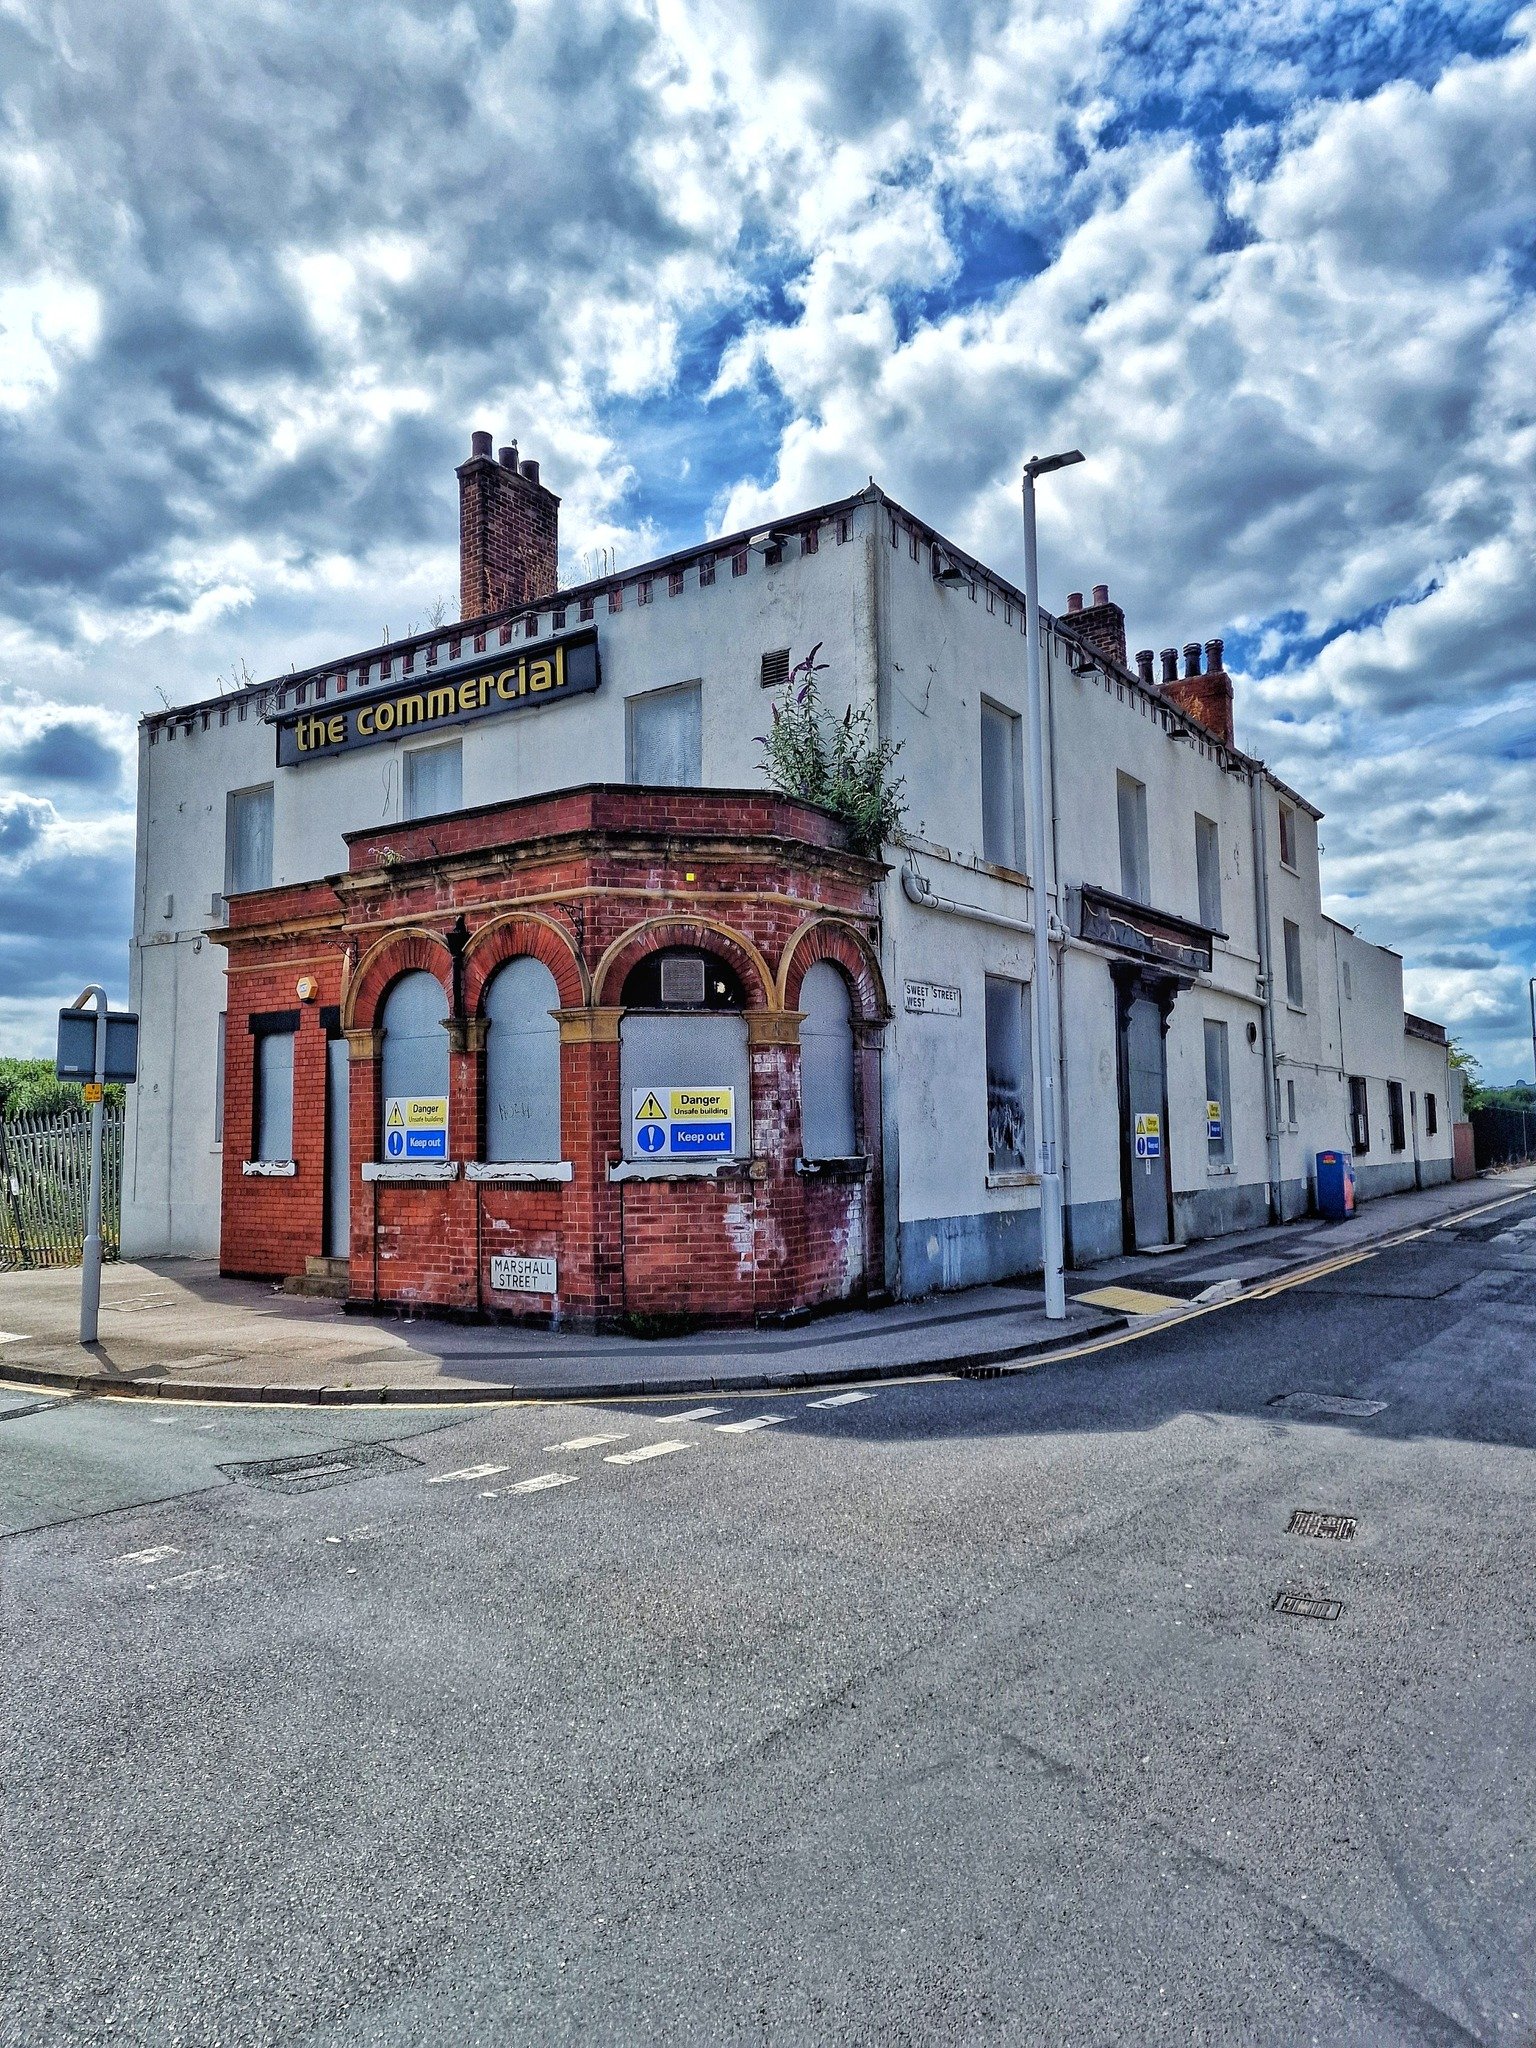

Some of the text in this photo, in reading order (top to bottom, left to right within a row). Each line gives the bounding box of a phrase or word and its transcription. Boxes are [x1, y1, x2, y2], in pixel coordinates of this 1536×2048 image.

[295, 646, 564, 751] the commercial
[906, 984, 957, 1001] SWEET STREET
[906, 996, 926, 1008] WEST
[680, 1094, 721, 1107] Danger
[412, 1103, 439, 1115] Danger
[700, 1107, 728, 1116] building
[424, 1115, 444, 1124] building
[410, 1137, 441, 1148] Keep out
[677, 1131, 725, 1143] Keep out
[494, 1259, 552, 1275] MARSHALL
[499, 1273, 538, 1289] STREET
